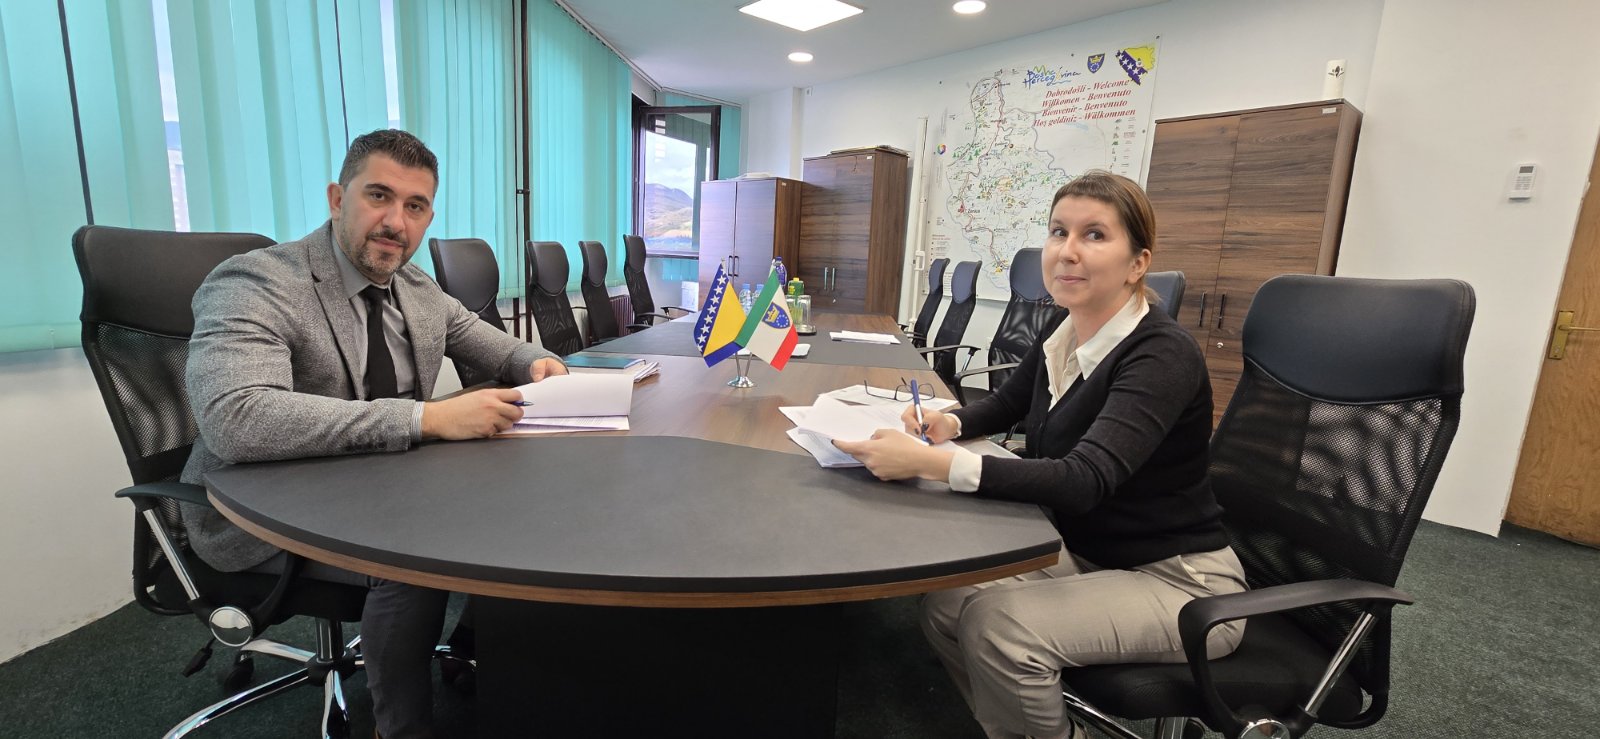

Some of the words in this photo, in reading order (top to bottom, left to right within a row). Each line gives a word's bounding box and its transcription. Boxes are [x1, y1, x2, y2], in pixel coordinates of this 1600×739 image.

[1045, 85, 1086, 98] Dobrodošli
[1093, 79, 1130, 90] Welcome
[1087, 89, 1132, 101] Benvenuto
[1041, 105, 1078, 117] Bienvenir
[1084, 100, 1128, 111] Benvenuto
[1047, 114, 1077, 127] geldiniz
[1084, 109, 1136, 120] Wälkommen
